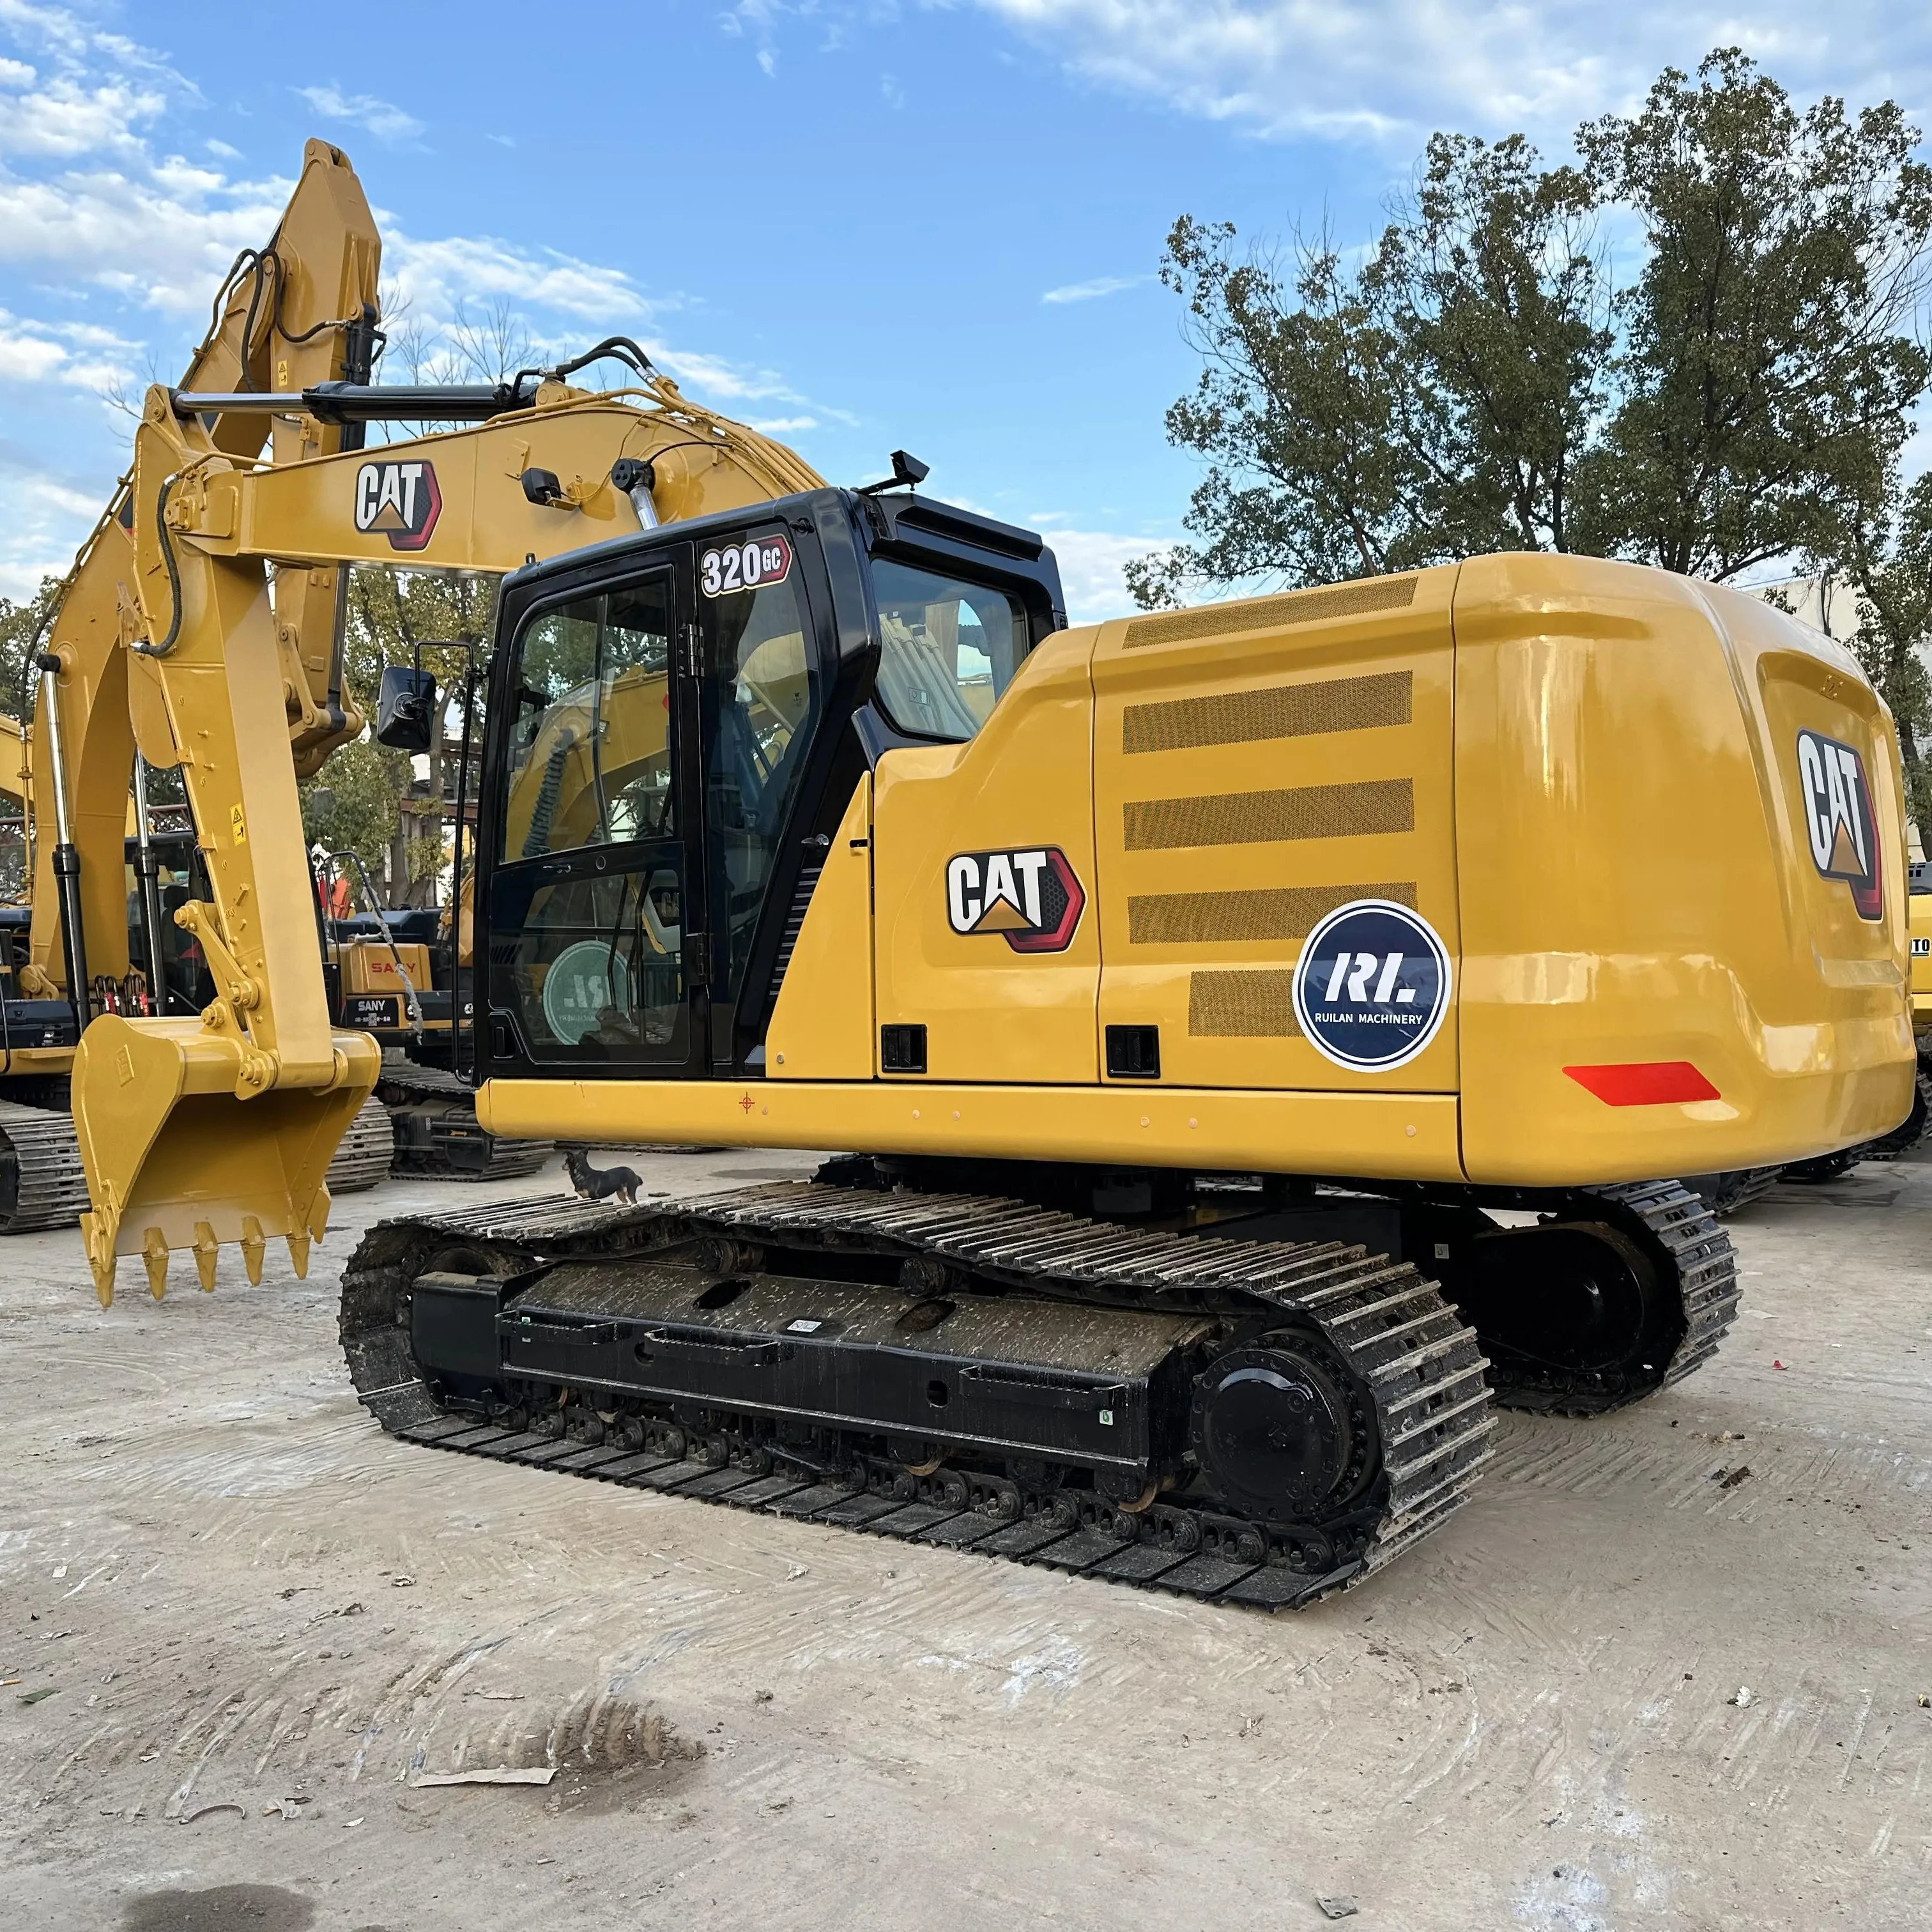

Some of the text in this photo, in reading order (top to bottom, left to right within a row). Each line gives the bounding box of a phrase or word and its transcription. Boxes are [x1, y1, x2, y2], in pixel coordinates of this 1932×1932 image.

[356, 463, 422, 530] CAT
[1798, 734, 1868, 876] CAT
[948, 851, 1046, 931] CAT
[1910, 939, 1930, 952] TO
[1324, 953, 1416, 1003] RL
[358, 1000, 385, 1011] SANY
[1315, 1013, 1423, 1025] RUILAN MACHINERY
